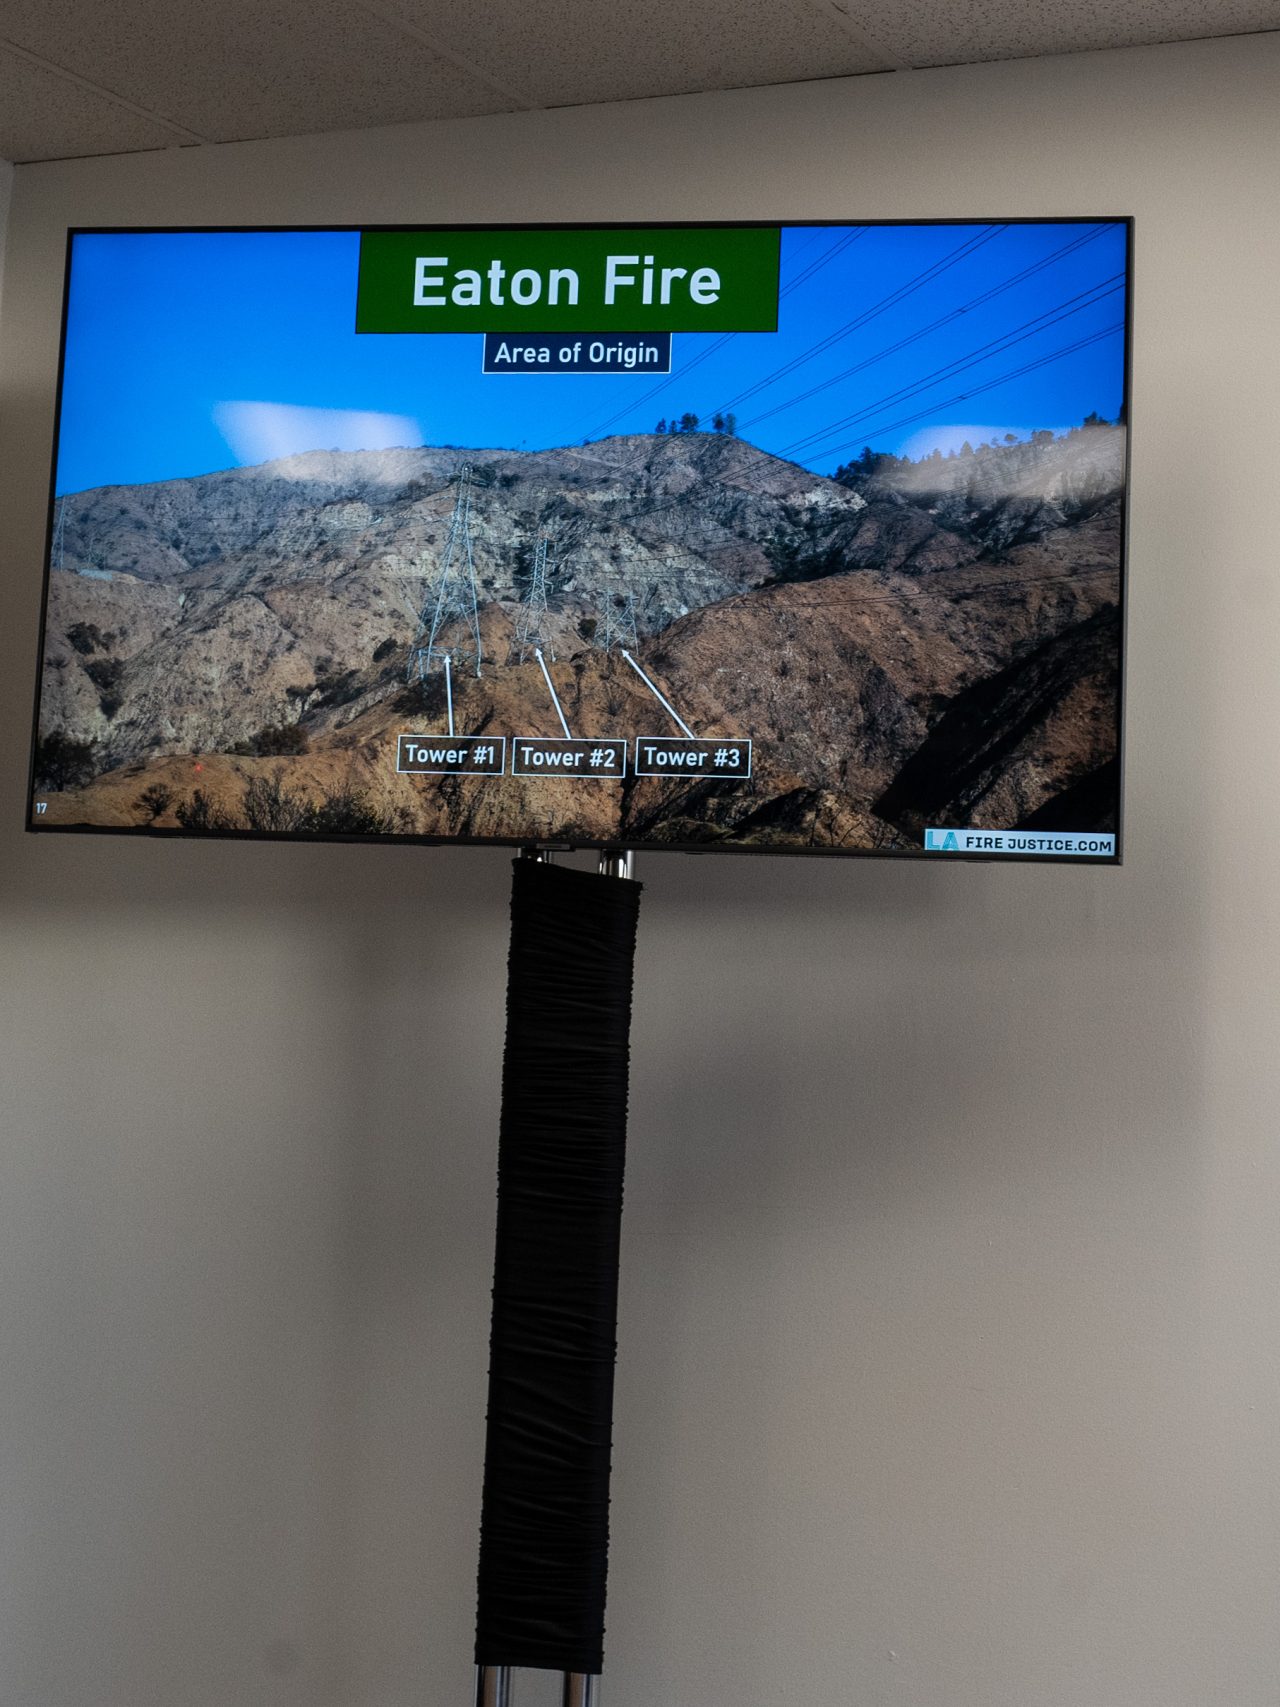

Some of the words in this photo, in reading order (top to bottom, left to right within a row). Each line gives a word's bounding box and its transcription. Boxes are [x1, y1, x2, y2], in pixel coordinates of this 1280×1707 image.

[413, 256, 579, 306] Eaton
[604, 255, 721, 306] Fire
[494, 343, 550, 364] Area
[559, 342, 581, 363] of
[589, 341, 659, 368] Origin
[405, 744, 467, 764] Tower
[473, 746, 495, 765] #1
[521, 747, 584, 767] Tower
[589, 748, 615, 768] #2
[644, 746, 707, 767] Tower
[713, 748, 740, 768] #3
[36, 802, 48, 814] 17
[927, 831, 960, 851] LA
[966, 837, 1003, 849] FIRE
[1008, 838, 1112, 852] JUSTICE.COM
